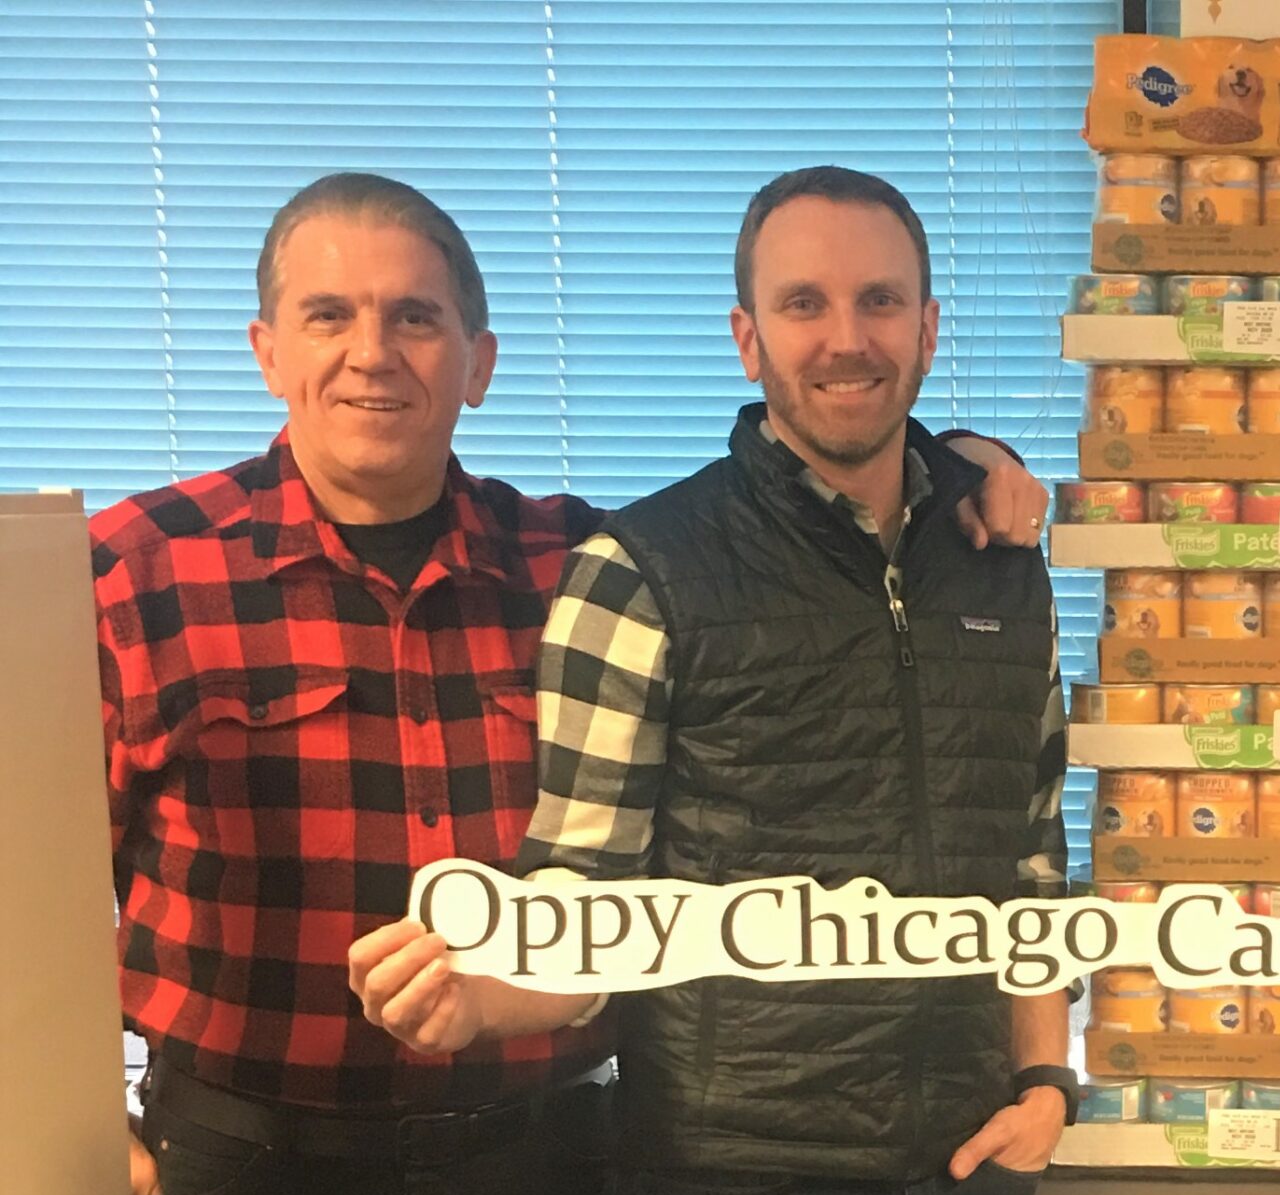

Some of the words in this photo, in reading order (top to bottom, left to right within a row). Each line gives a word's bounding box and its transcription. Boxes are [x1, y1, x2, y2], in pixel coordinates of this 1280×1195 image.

[1126, 72, 1192, 96] Pedigree
[1174, 536, 1216, 552] Friskies
[1233, 531, 1279, 551] Paté
[1196, 736, 1236, 752] Friskies
[419, 868, 693, 976] Oppy
[720, 882, 1119, 988] Chicago
